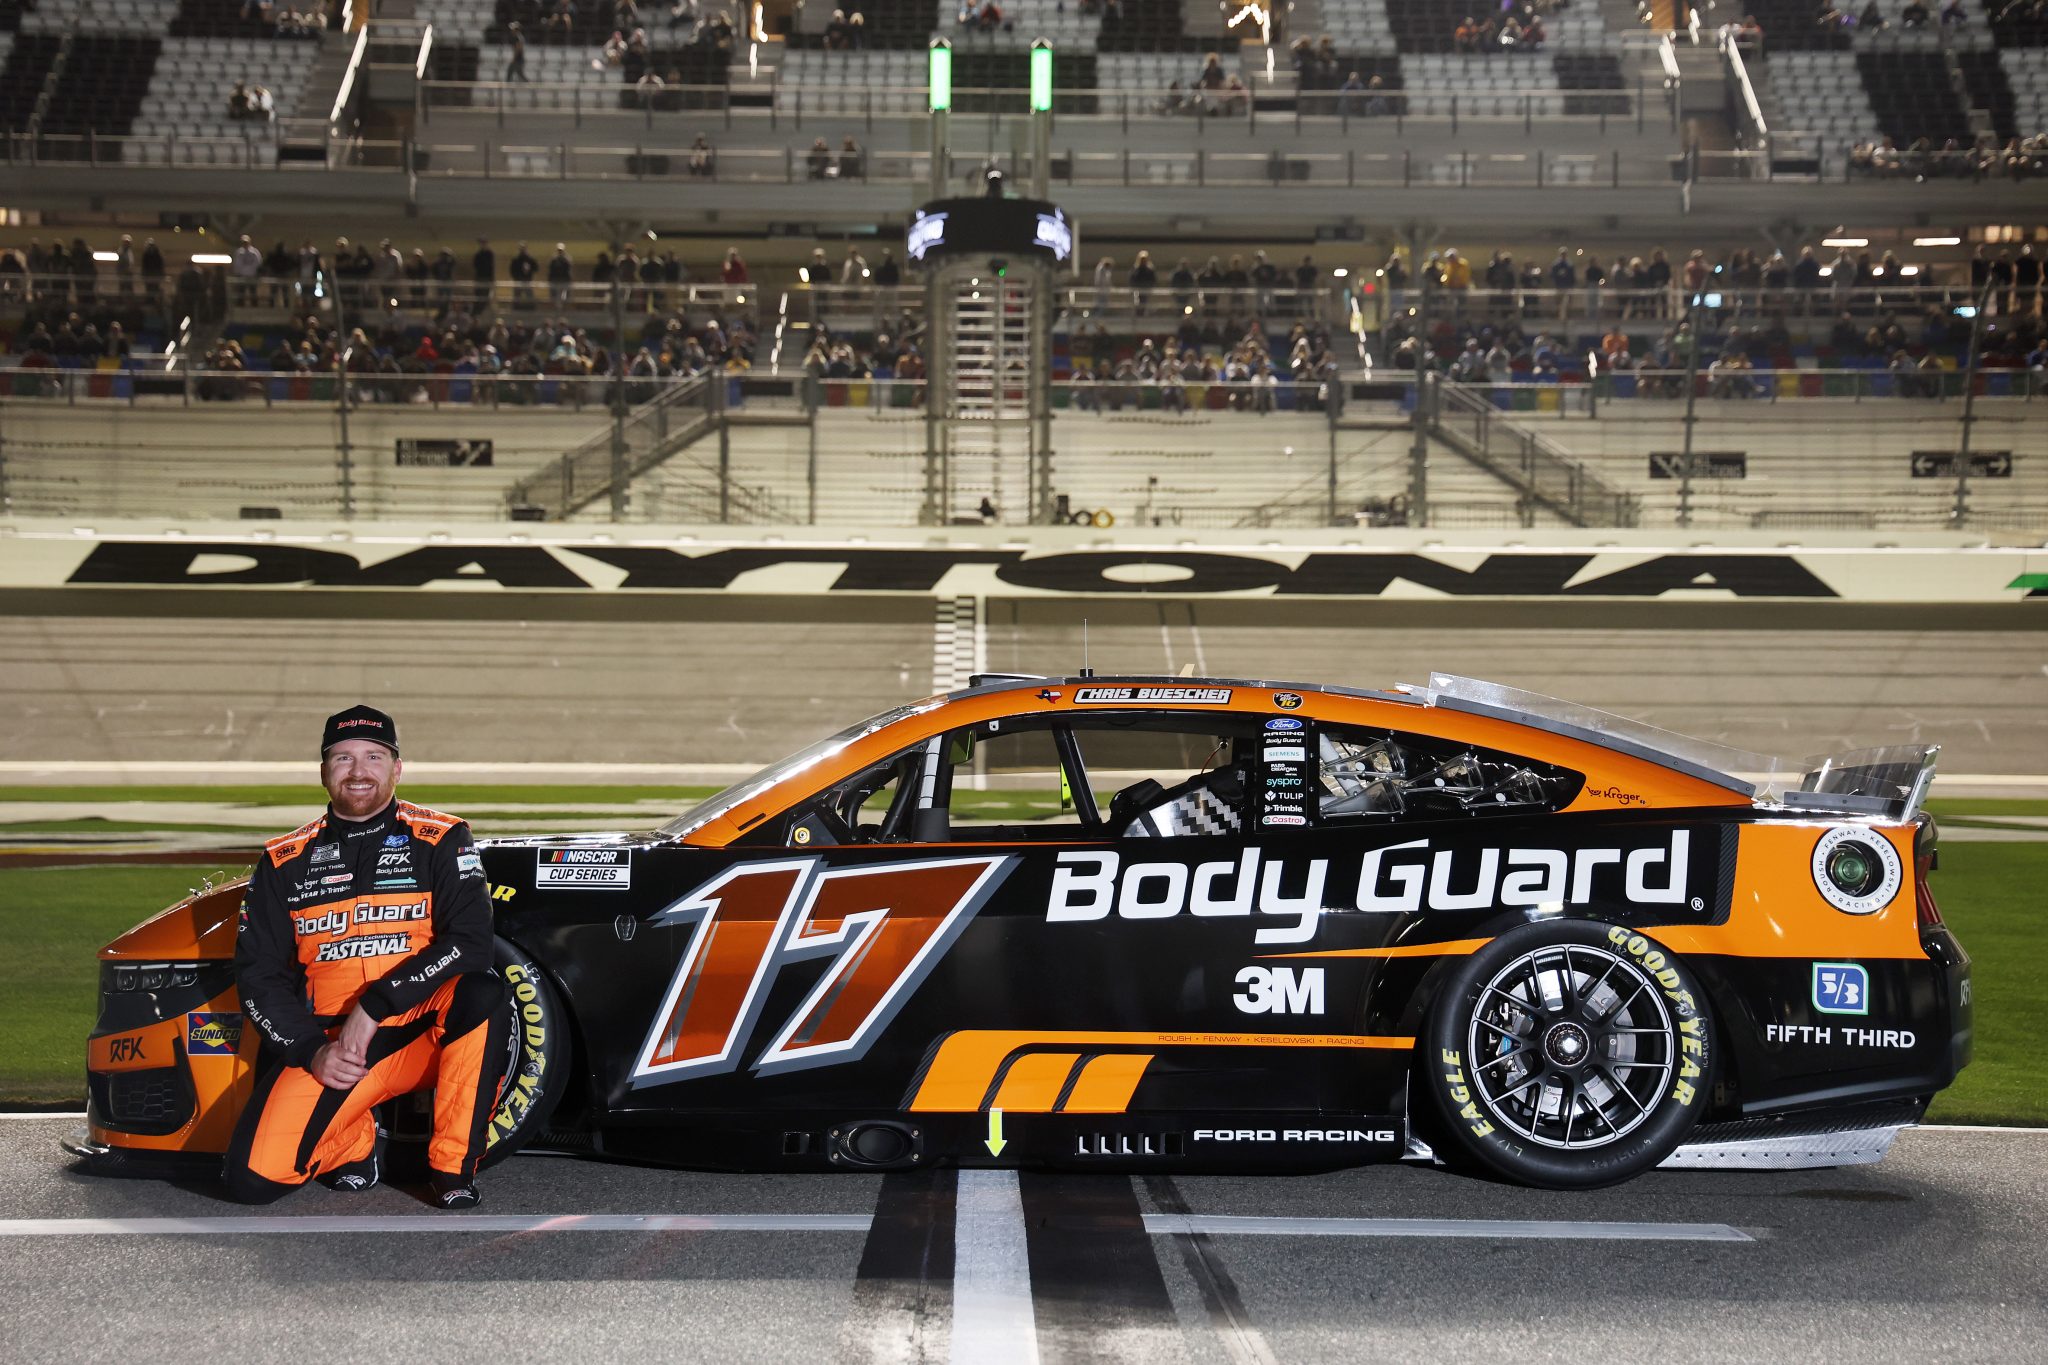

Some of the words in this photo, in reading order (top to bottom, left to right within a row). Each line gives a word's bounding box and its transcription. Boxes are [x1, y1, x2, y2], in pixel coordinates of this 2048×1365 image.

[65, 541, 1842, 598] DAYTONA
[1075, 688, 1132, 703] CHRIS
[1137, 688, 1232, 703] BUESCHER
[1271, 720, 1295, 728] Ford
[1266, 778, 1302, 787] syspro
[1278, 792, 1304, 800] TULIP
[1603, 786, 1640, 805] Kroger
[1273, 804, 1303, 812] Trimble
[420, 827, 440, 837] OMP
[1824, 830, 1857, 849] FENWAY
[276, 847, 296, 858] OMP
[377, 852, 411, 866] RFK
[566, 851, 618, 863] NASCAR
[1869, 836, 1895, 893] KESELOWSKI
[327, 874, 351, 883] Castrol
[549, 869, 574, 881] CUP
[575, 868, 618, 881] SERIES
[1818, 860, 1832, 893] ROUSH
[1045, 846, 1328, 944] Body
[295, 909, 350, 936] Body
[353, 898, 428, 925] Guard
[315, 937, 412, 962] FASTENAL
[424, 945, 461, 978] Guard
[628, 852, 1023, 1089] 17
[1233, 967, 1324, 1014] 3M
[1607, 925, 1703, 1107] GOODYEAR
[190, 1028, 240, 1040] SUNOCO
[1326, 1037, 1365, 1045] RACING
[1766, 1025, 1832, 1045] FIFTH
[1841, 1028, 1916, 1049] THIRD
[109, 1036, 146, 1063] RFK
[1442, 1048, 1495, 1138] EAGLE
[1193, 1130, 1276, 1141] FORD
[1283, 1130, 1395, 1142] RACING
